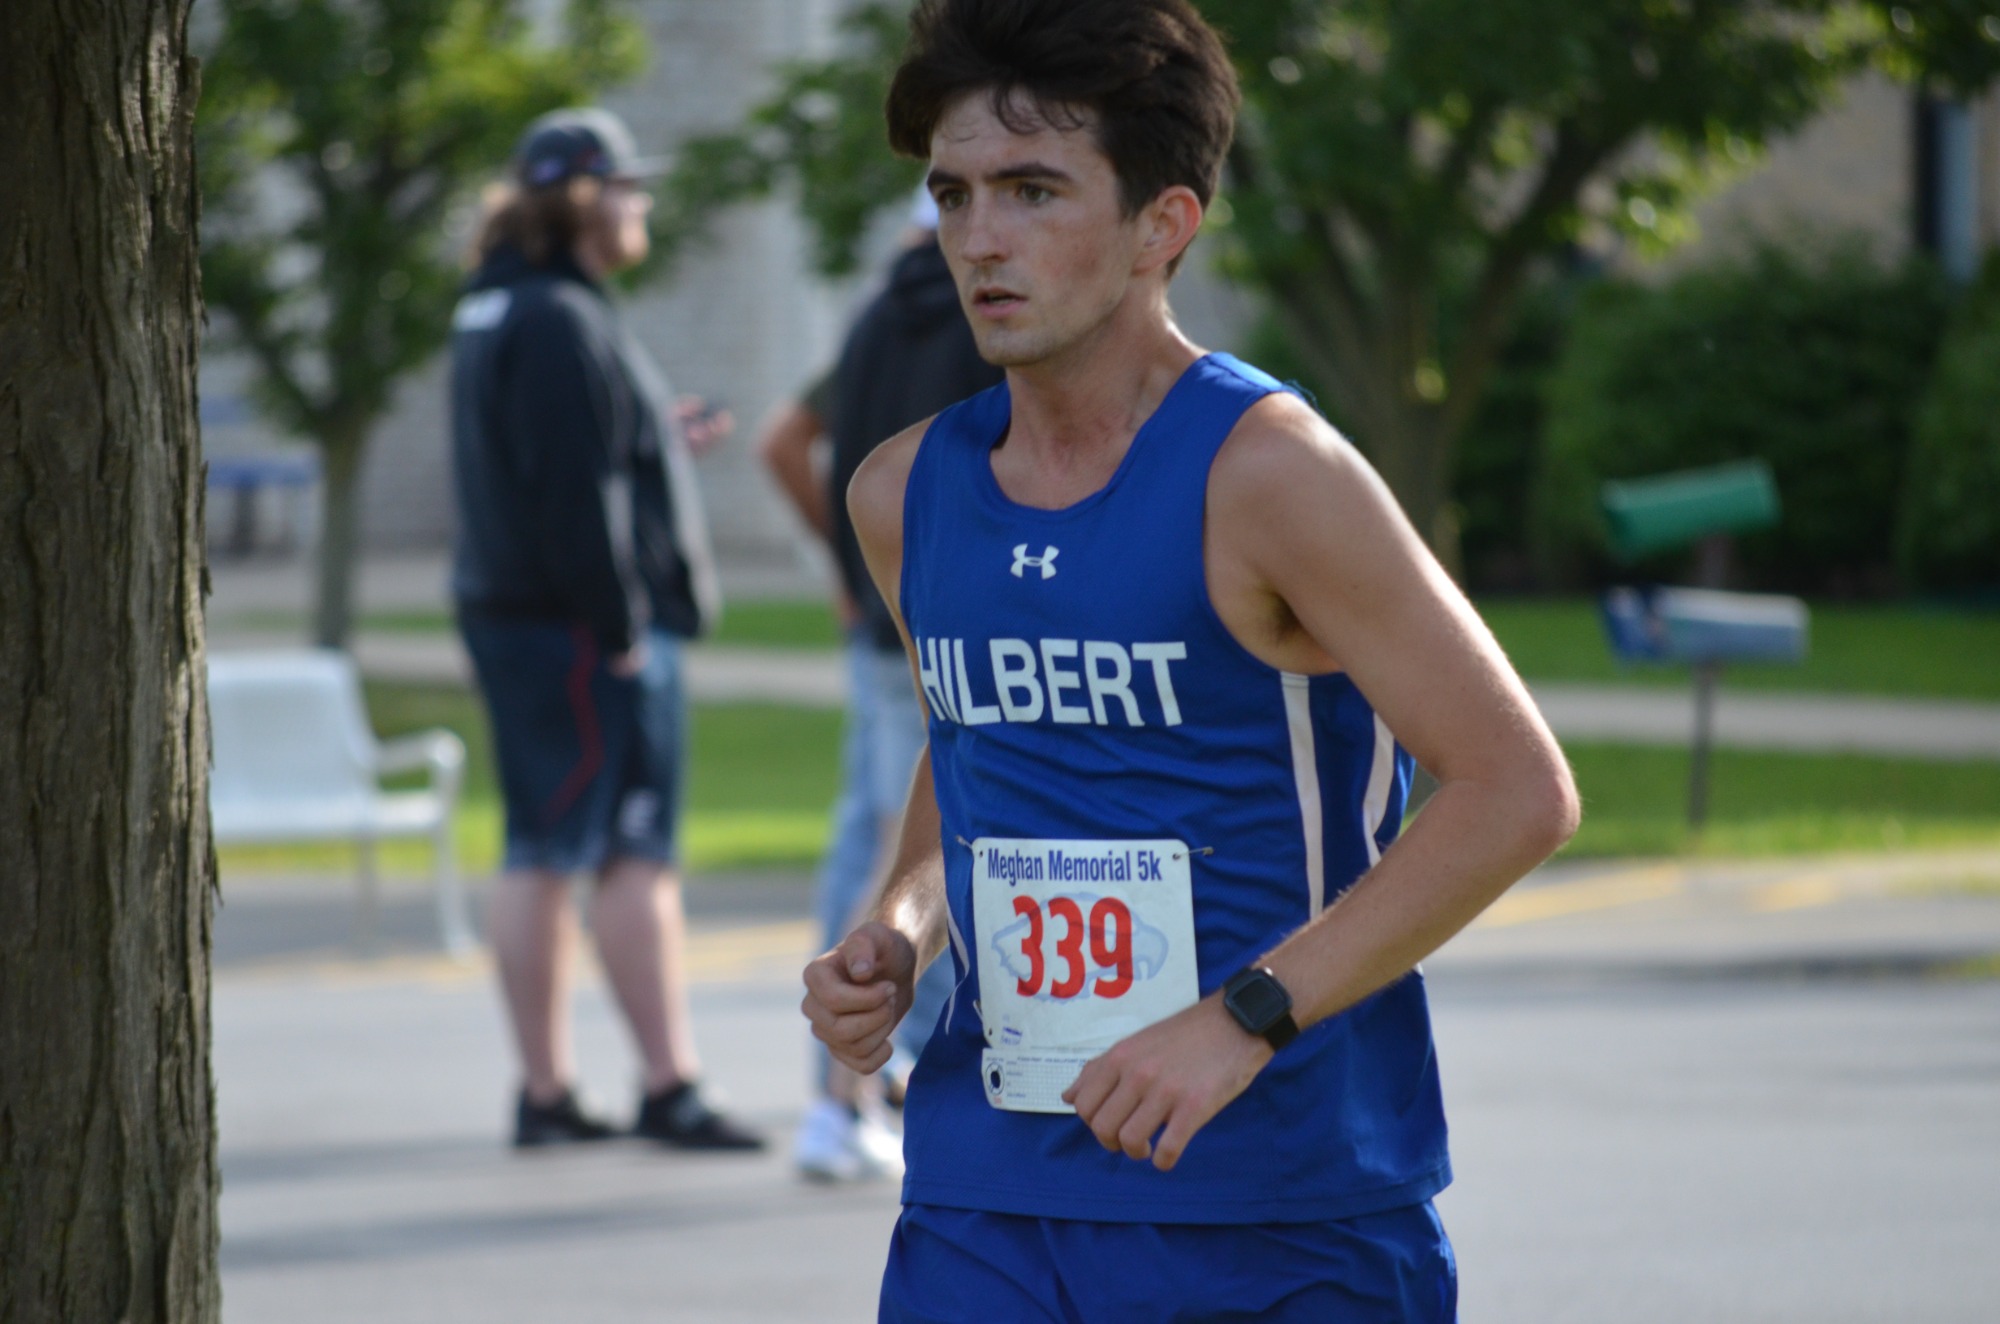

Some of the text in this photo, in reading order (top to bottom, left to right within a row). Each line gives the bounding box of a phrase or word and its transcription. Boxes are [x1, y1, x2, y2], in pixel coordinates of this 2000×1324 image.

[916, 636, 1187, 726] HILBERT
[988, 848, 1162, 886] Meghan Memorial 5k
[1012, 895, 1134, 999] 339
